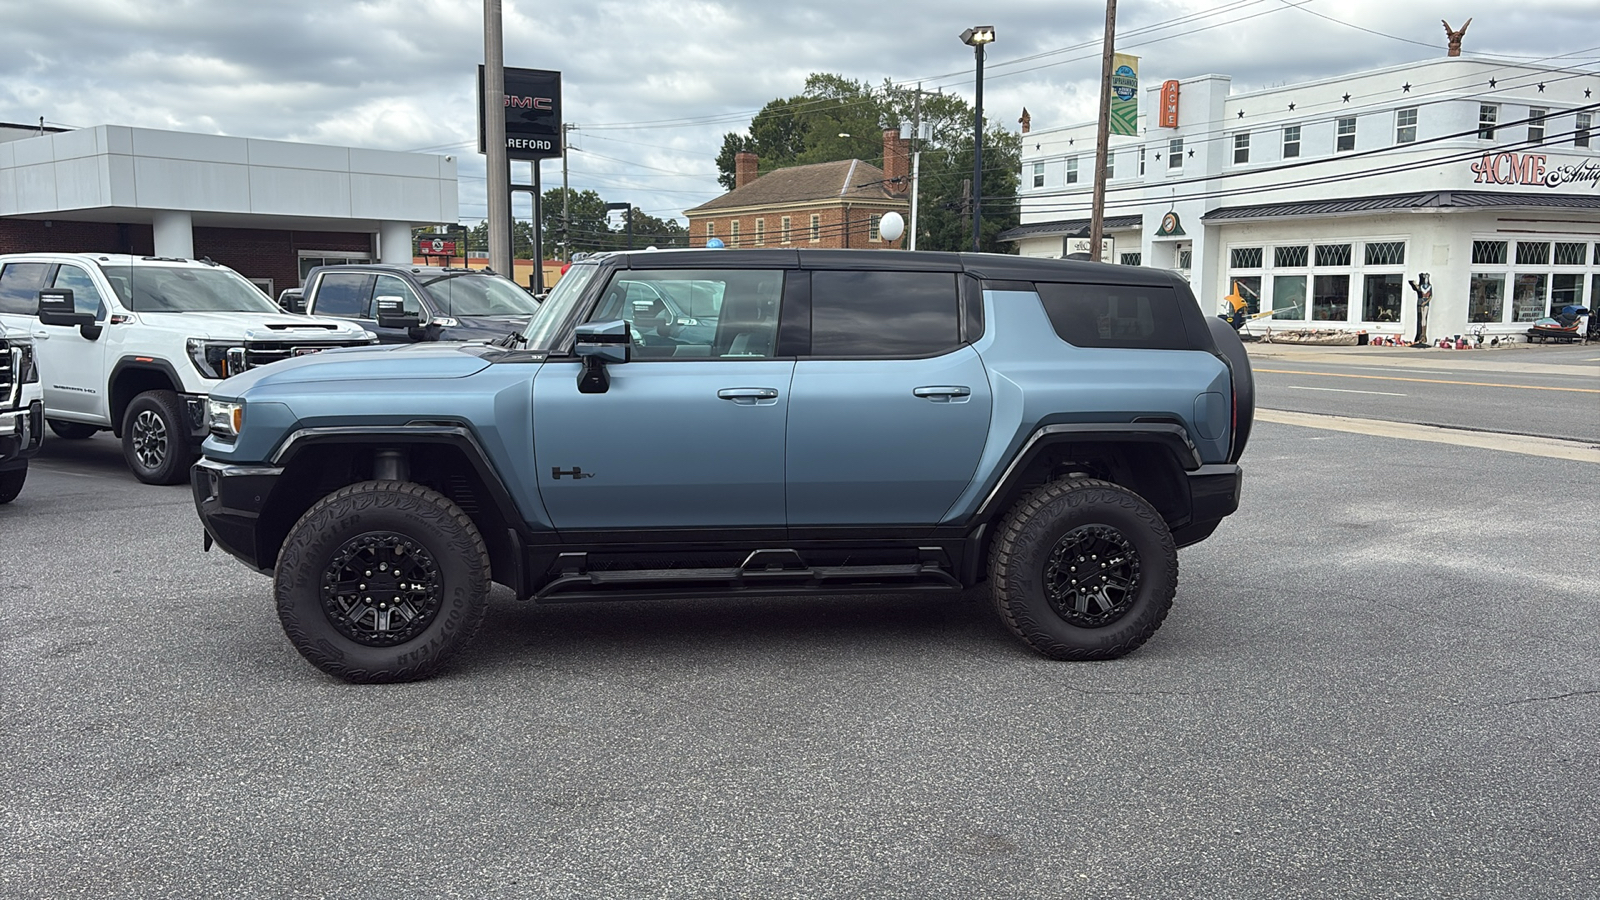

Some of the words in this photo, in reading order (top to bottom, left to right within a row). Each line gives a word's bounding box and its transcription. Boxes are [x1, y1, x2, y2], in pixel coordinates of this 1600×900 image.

[1168, 83, 1177, 124] ACME
[505, 138, 551, 150] REFORD
[1471, 151, 1547, 186] ACME
[296, 514, 361, 588] WRANGLER
[397, 586, 466, 666] GOODYEAR
